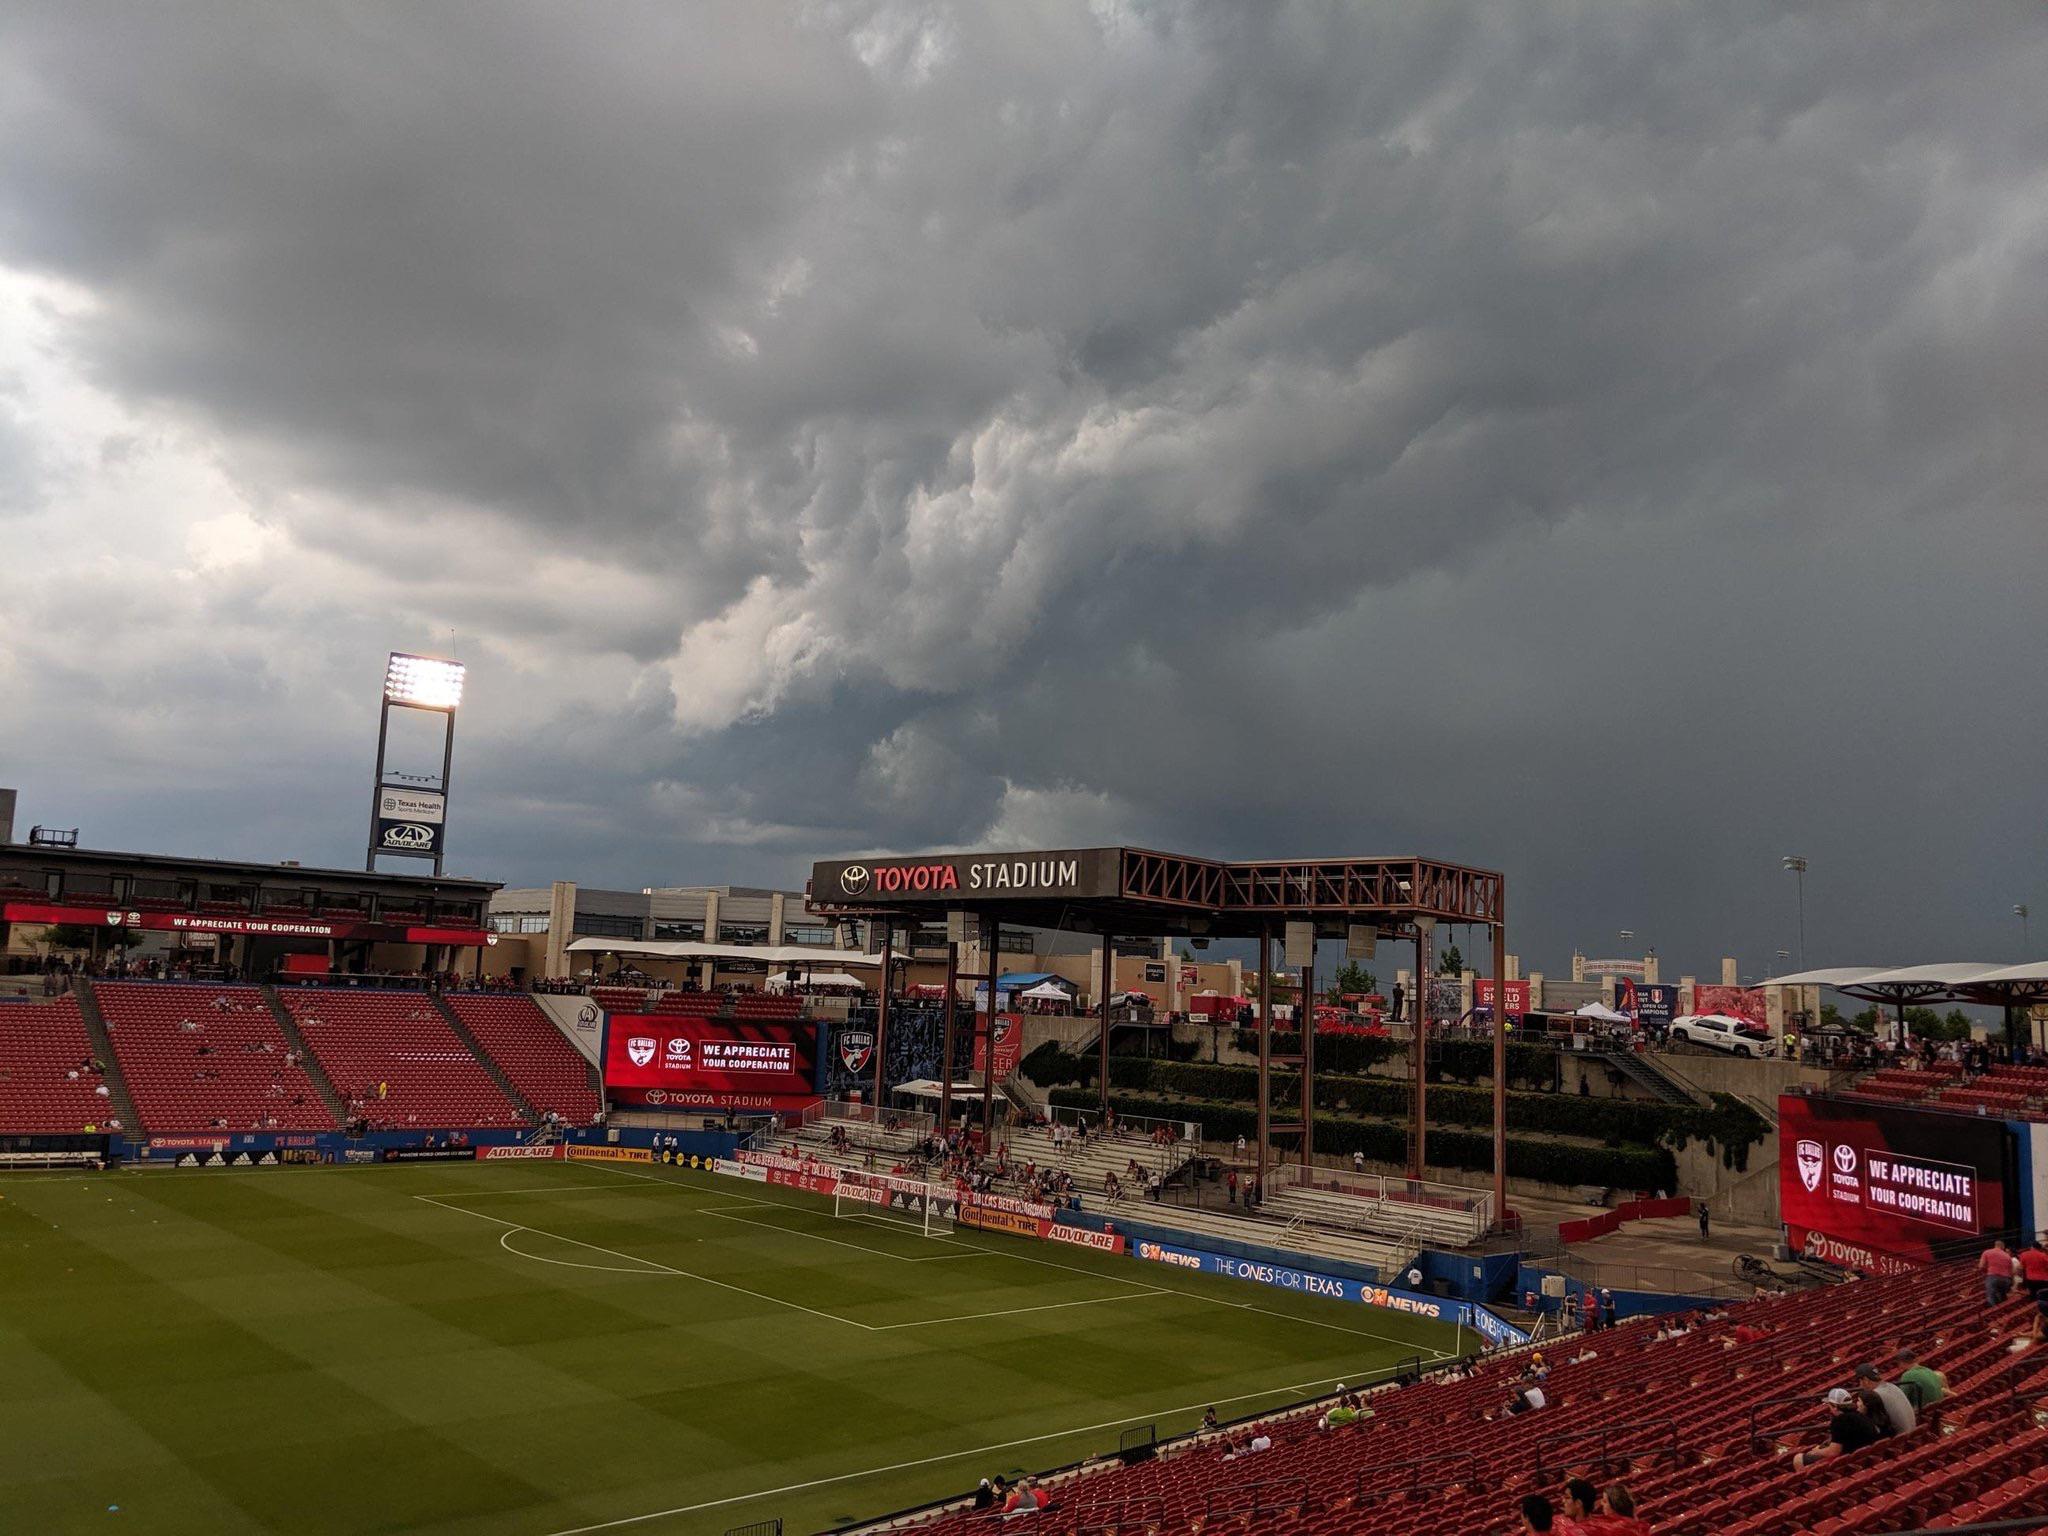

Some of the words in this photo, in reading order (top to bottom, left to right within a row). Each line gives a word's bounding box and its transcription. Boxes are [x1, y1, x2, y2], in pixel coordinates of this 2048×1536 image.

[398, 800, 417, 808] Texas
[419, 801, 441, 810] Health
[383, 839, 431, 849] ADVOCARE
[874, 866, 959, 891] TOYOTA
[970, 860, 1077, 889] STADIUM
[174, 918, 187, 926] WE
[190, 919, 243, 930] APPRECIATE
[246, 922, 269, 931] YOUR
[271, 924, 332, 935] COOPERATION
[851, 1035, 870, 1045] DALLAS
[703, 1045, 720, 1055] WE
[724, 1046, 790, 1058] APPRECIATE
[702, 1059, 726, 1068] YOUR
[728, 1060, 789, 1070] COOPERATION
[670, 1093, 715, 1104] TOYOTA
[720, 1095, 772, 1107] STADIUM
[487, 1146, 554, 1159] ADVOCARE
[566, 1145, 619, 1158] Continental
[1832, 1173, 1859, 1187] TOYOTA
[1869, 1160, 1888, 1180] WE
[1891, 1164, 1971, 1197] APPRECIATE
[972, 1192, 997, 1208] DALLAS
[998, 1196, 1015, 1212] BEER
[1832, 1189, 1860, 1203] STADIUM
[1870, 1186, 1896, 1205] YOUR
[1898, 1192, 1972, 1222] COOPERATION
[1017, 1220, 1037, 1231] TIRE
[1048, 1225, 1113, 1250] ADVOCARE
[1160, 1250, 1201, 1269] NEWS
[1828, 1240, 1875, 1269] TOYOTA
[1214, 1257, 1235, 1275] THE
[1238, 1262, 1273, 1283] ONES
[1275, 1269, 1300, 1288] FOR
[1304, 1274, 1344, 1297] TEXAS
[1387, 1295, 1440, 1318] NEWS
